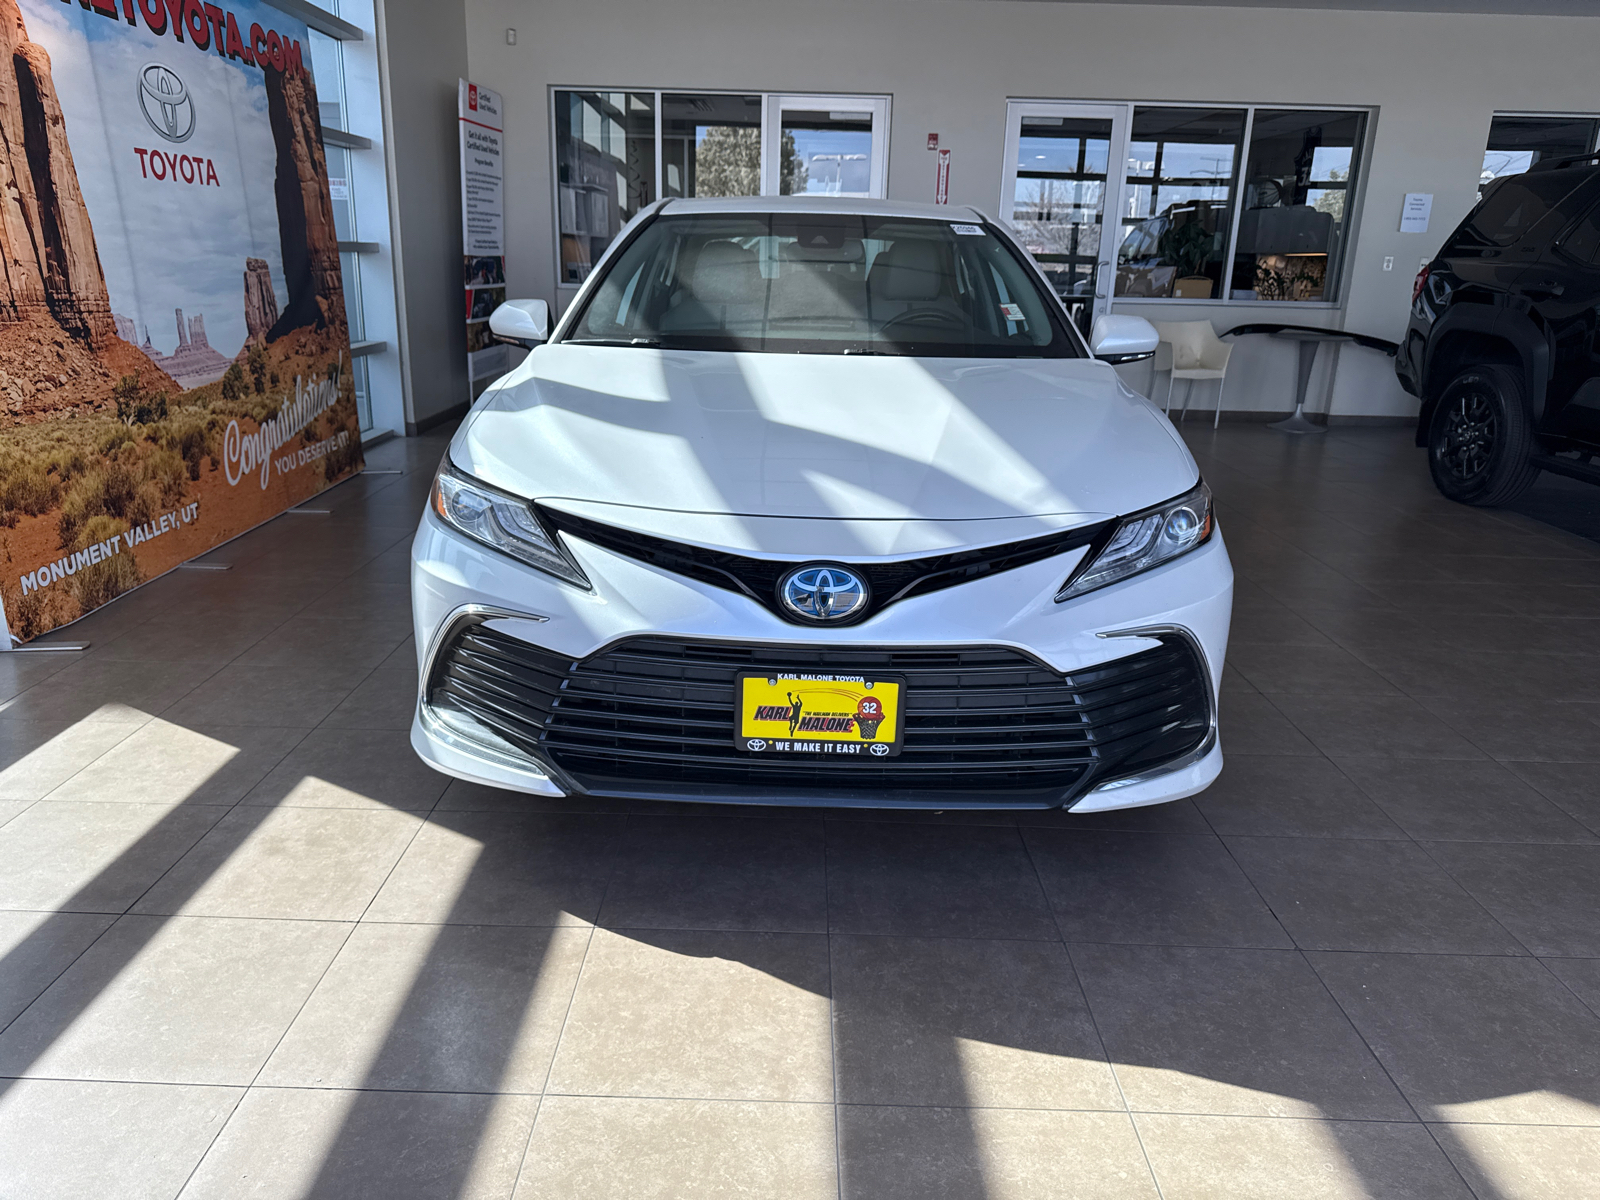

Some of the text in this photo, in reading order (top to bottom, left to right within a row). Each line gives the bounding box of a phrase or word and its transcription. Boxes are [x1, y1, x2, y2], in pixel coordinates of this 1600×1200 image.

[133, 147, 221, 187] TOYOTA
[223, 348, 343, 490] Congratulations!
[274, 430, 350, 475] YOU DESERVE IT!
[20, 502, 199, 596] MONUMENT VALLEY, UT
[777, 673, 865, 683] KARL MALONE TOYOTA
[753, 705, 792, 721] KARL
[862, 702, 877, 714] 32
[797, 716, 855, 733] MALONE
[775, 742, 862, 754] WE MAKE IT EASY
